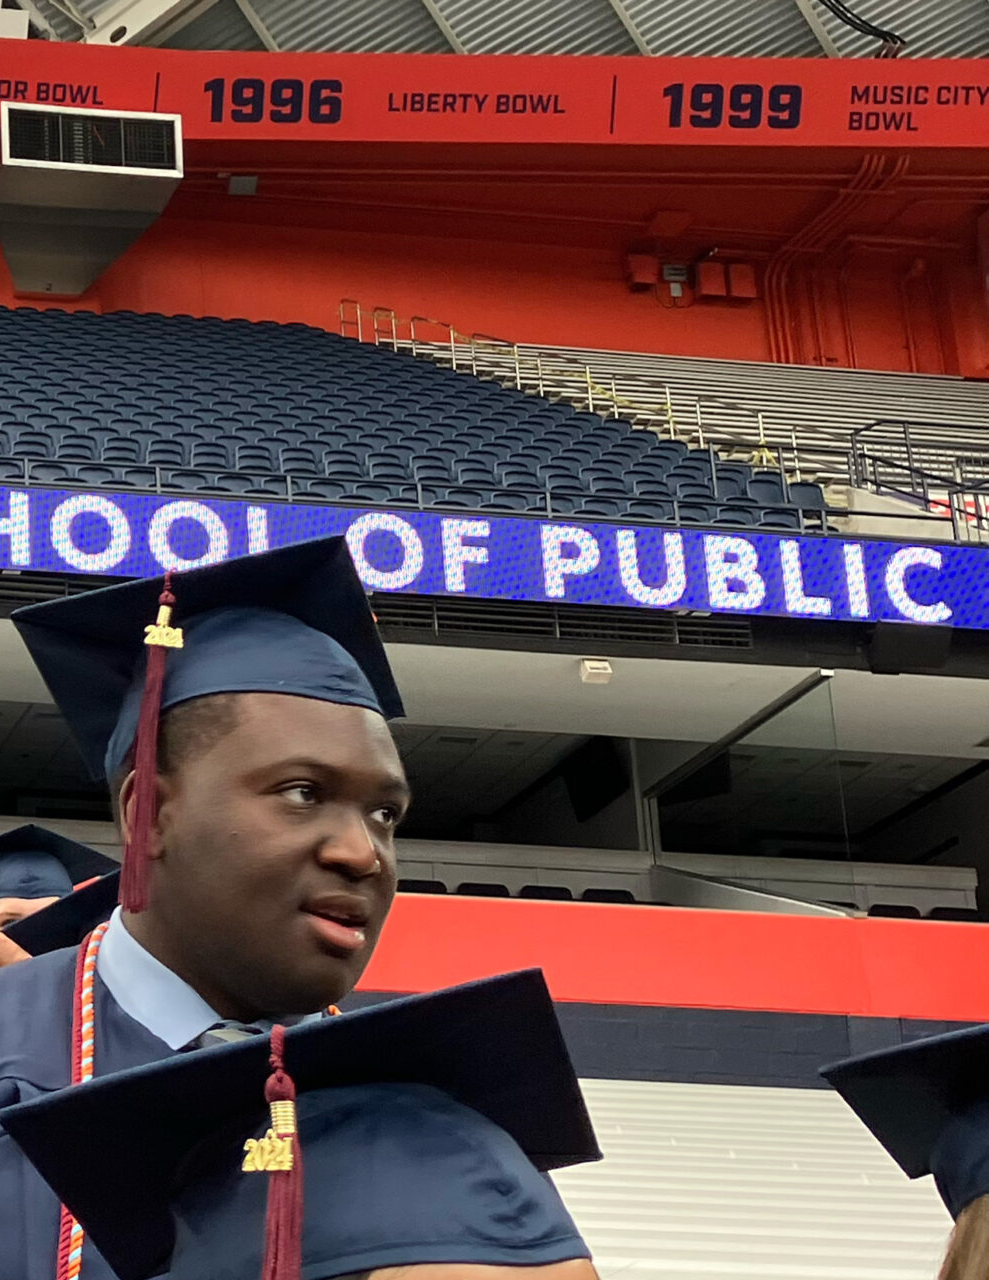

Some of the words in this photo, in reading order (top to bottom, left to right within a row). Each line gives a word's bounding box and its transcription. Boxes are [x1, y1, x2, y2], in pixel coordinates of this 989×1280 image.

[35, 82, 104, 106] BOWL
[203, 77, 343, 125] 1996
[387, 92, 489, 113] LIBERTY
[495, 93, 566, 114] BOWL
[662, 82, 803, 130] 1999
[850, 85, 930, 105] MUSIC
[936, 85, 989, 106] CITY
[848, 111, 919, 132] BOWL
[345, 511, 491, 593] OF
[540, 523, 953, 623] PUBLIC
